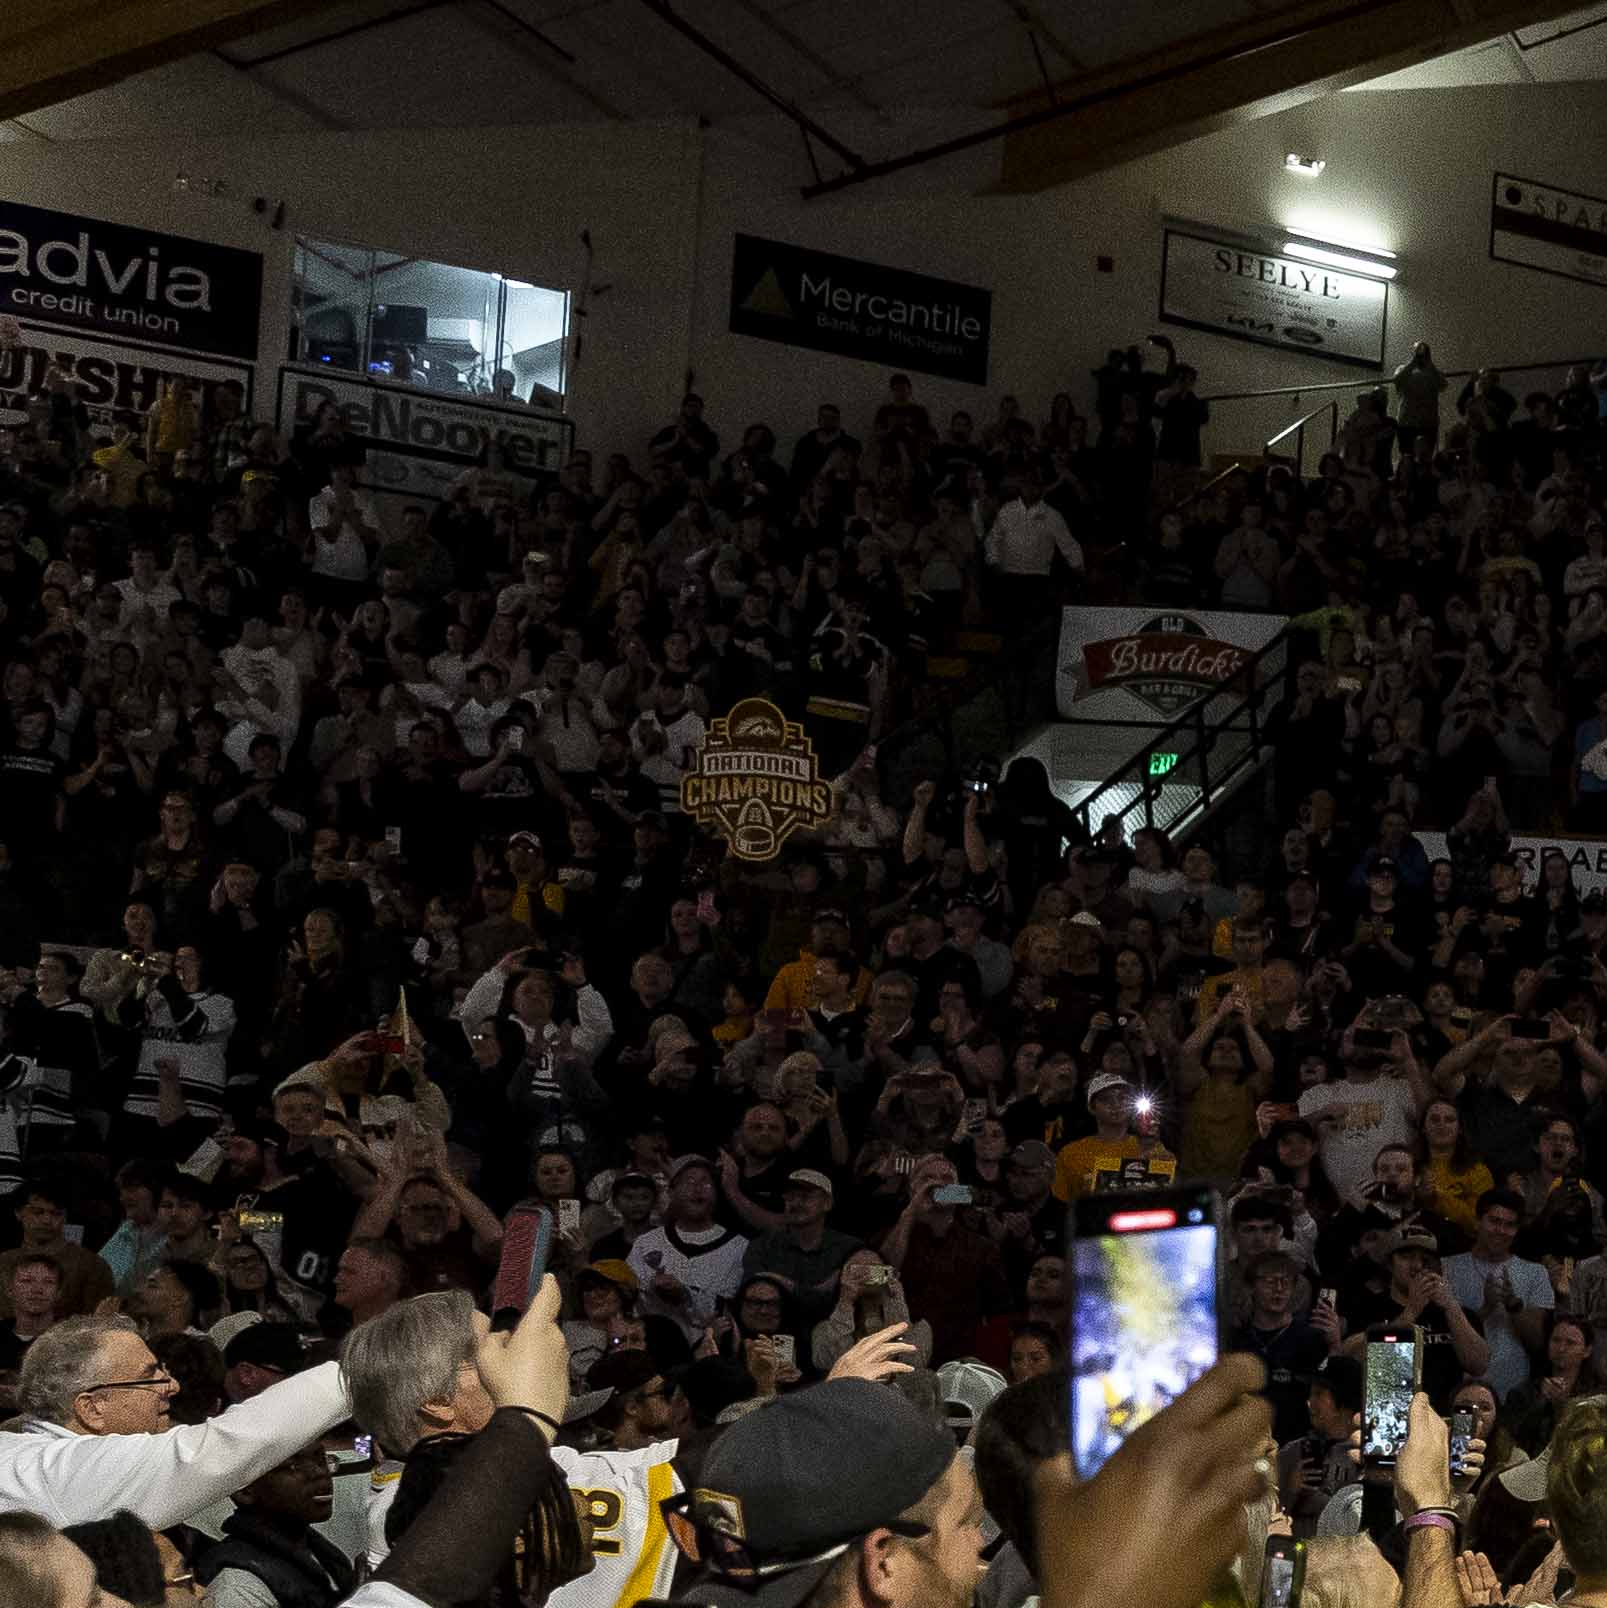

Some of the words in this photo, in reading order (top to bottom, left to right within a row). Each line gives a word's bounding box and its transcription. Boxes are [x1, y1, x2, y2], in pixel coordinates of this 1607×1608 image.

[0, 228, 211, 312] advia
[1215, 250, 1340, 300] SEELYE
[11, 287, 95, 318] credit
[103, 304, 180, 334] union
[801, 272, 981, 341] Mercantile
[706, 754, 809, 780] NATIONAL
[686, 775, 827, 815] CHAMPIONS
